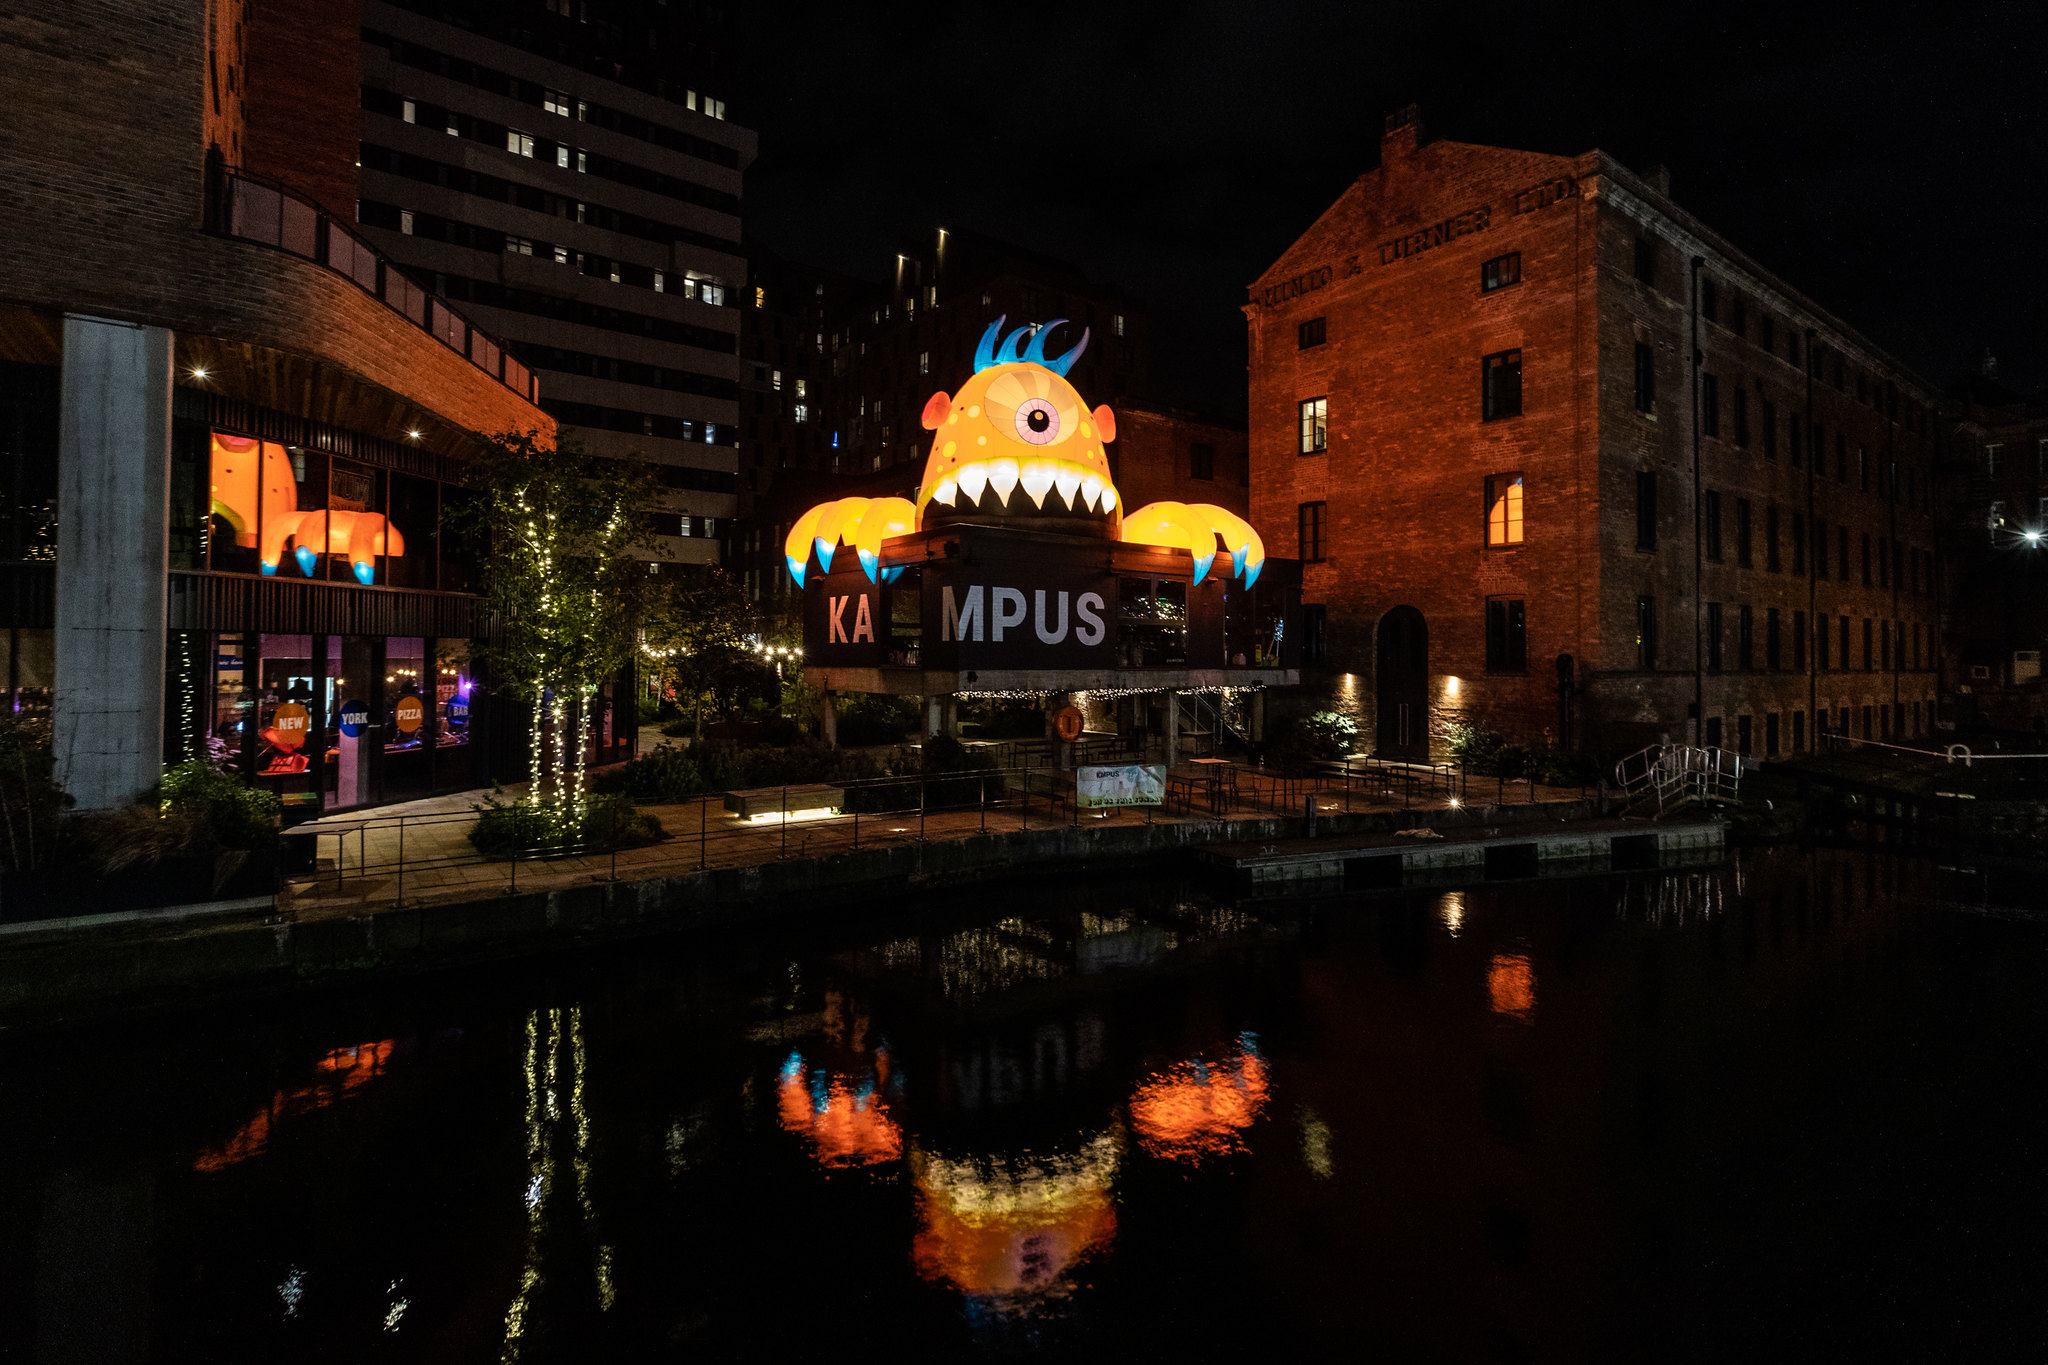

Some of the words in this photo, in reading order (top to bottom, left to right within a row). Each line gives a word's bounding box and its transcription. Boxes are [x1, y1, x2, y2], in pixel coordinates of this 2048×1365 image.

[1376, 204, 1491, 266] TURNER
[828, 594, 875, 644] KA
[941, 585, 1106, 647] MPUS
[279, 717, 304, 730] NEW
[341, 712, 368, 725] YORK
[397, 709, 421, 721] PIZZA
[453, 706, 469, 717] BAR
